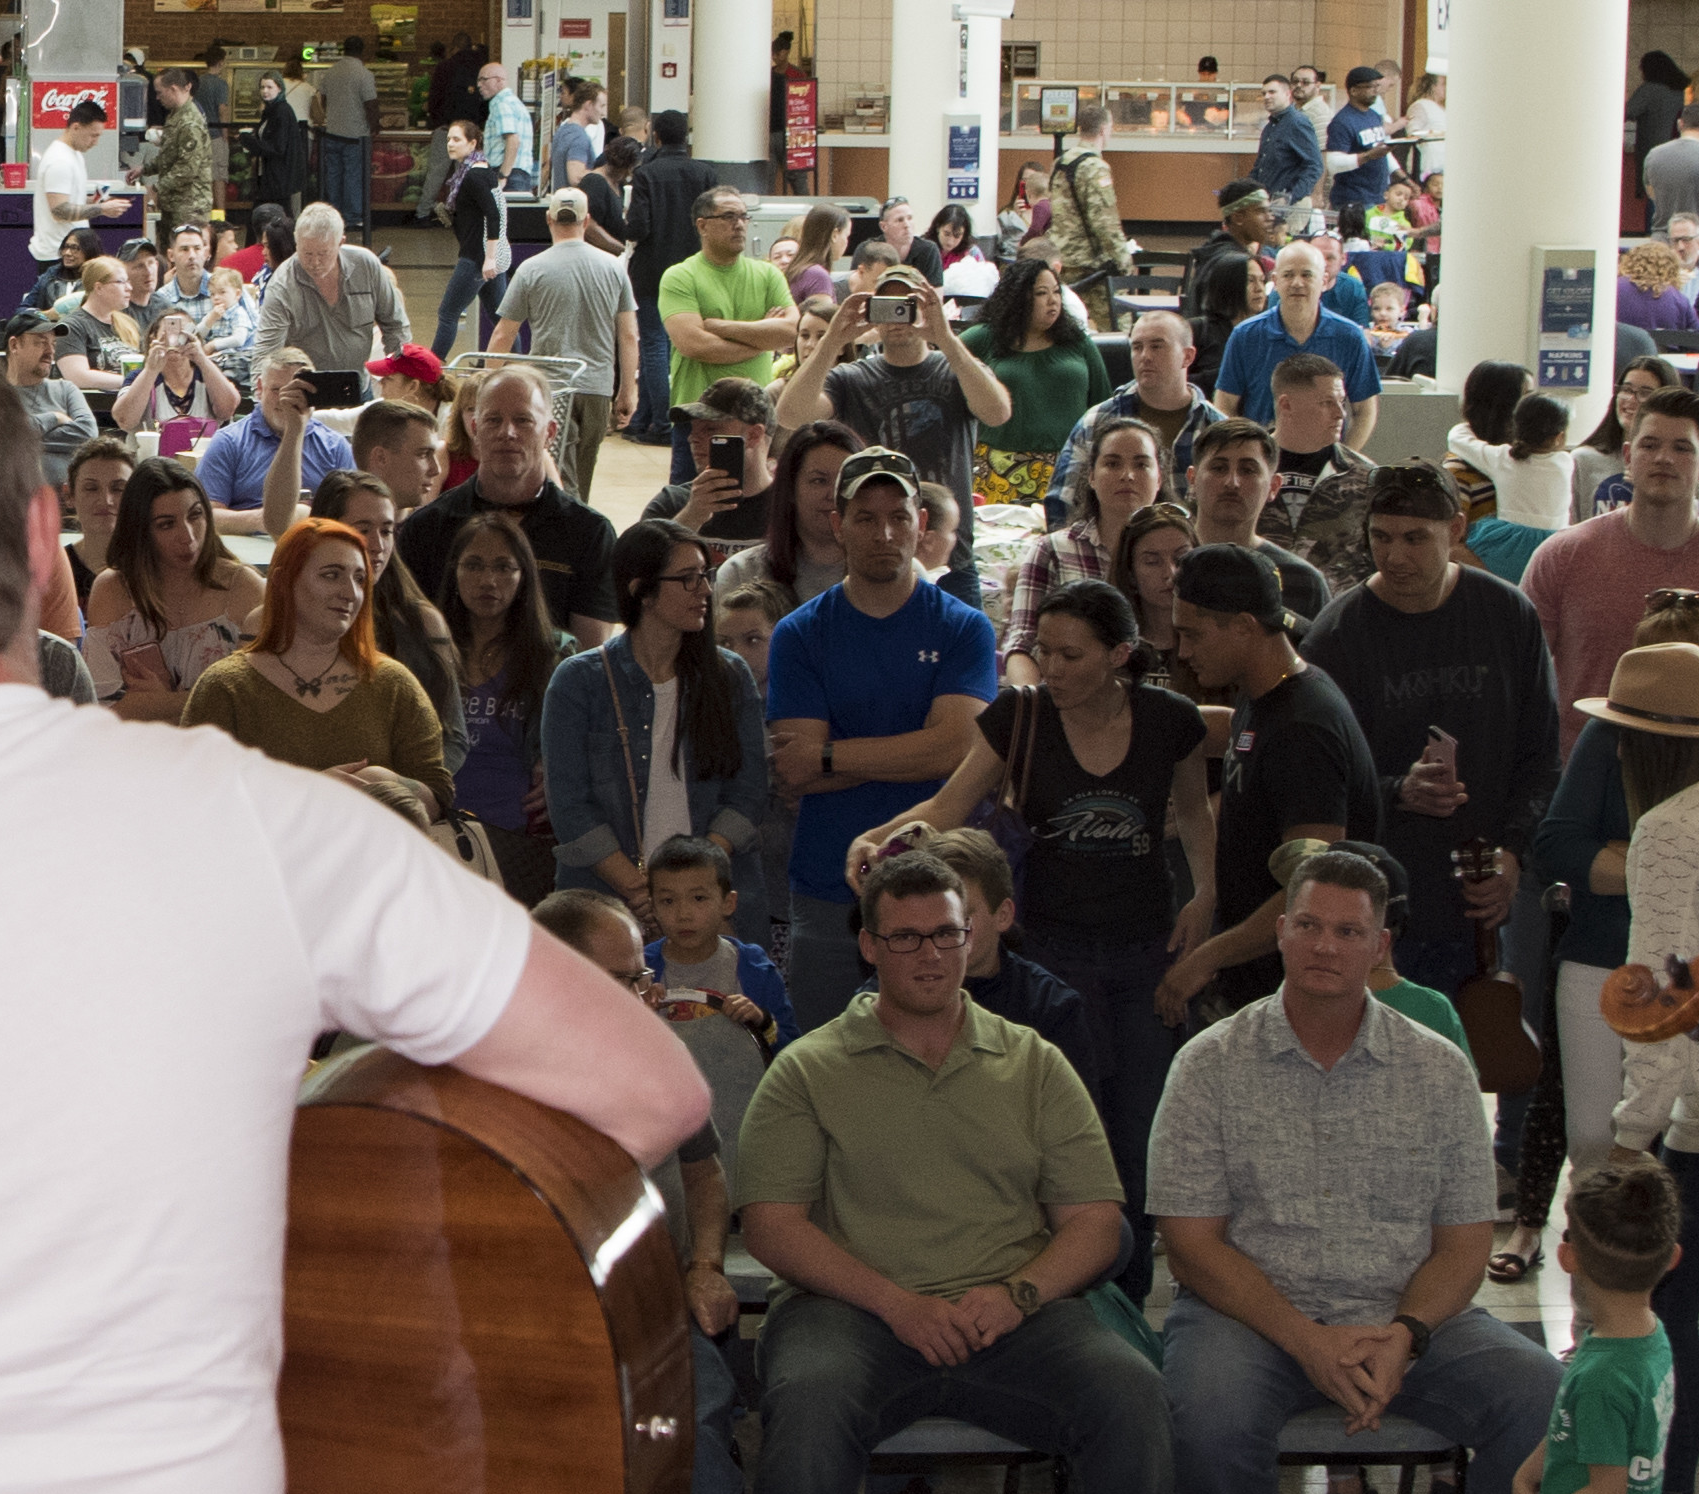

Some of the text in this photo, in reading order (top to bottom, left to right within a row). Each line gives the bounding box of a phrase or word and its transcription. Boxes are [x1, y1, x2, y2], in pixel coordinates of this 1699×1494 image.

[1548, 352, 1584, 360] NAPKINS
[1075, 791, 1093, 799] OLA
[1096, 789, 1120, 797] LOKO
[1130, 833, 1151, 856] 59
